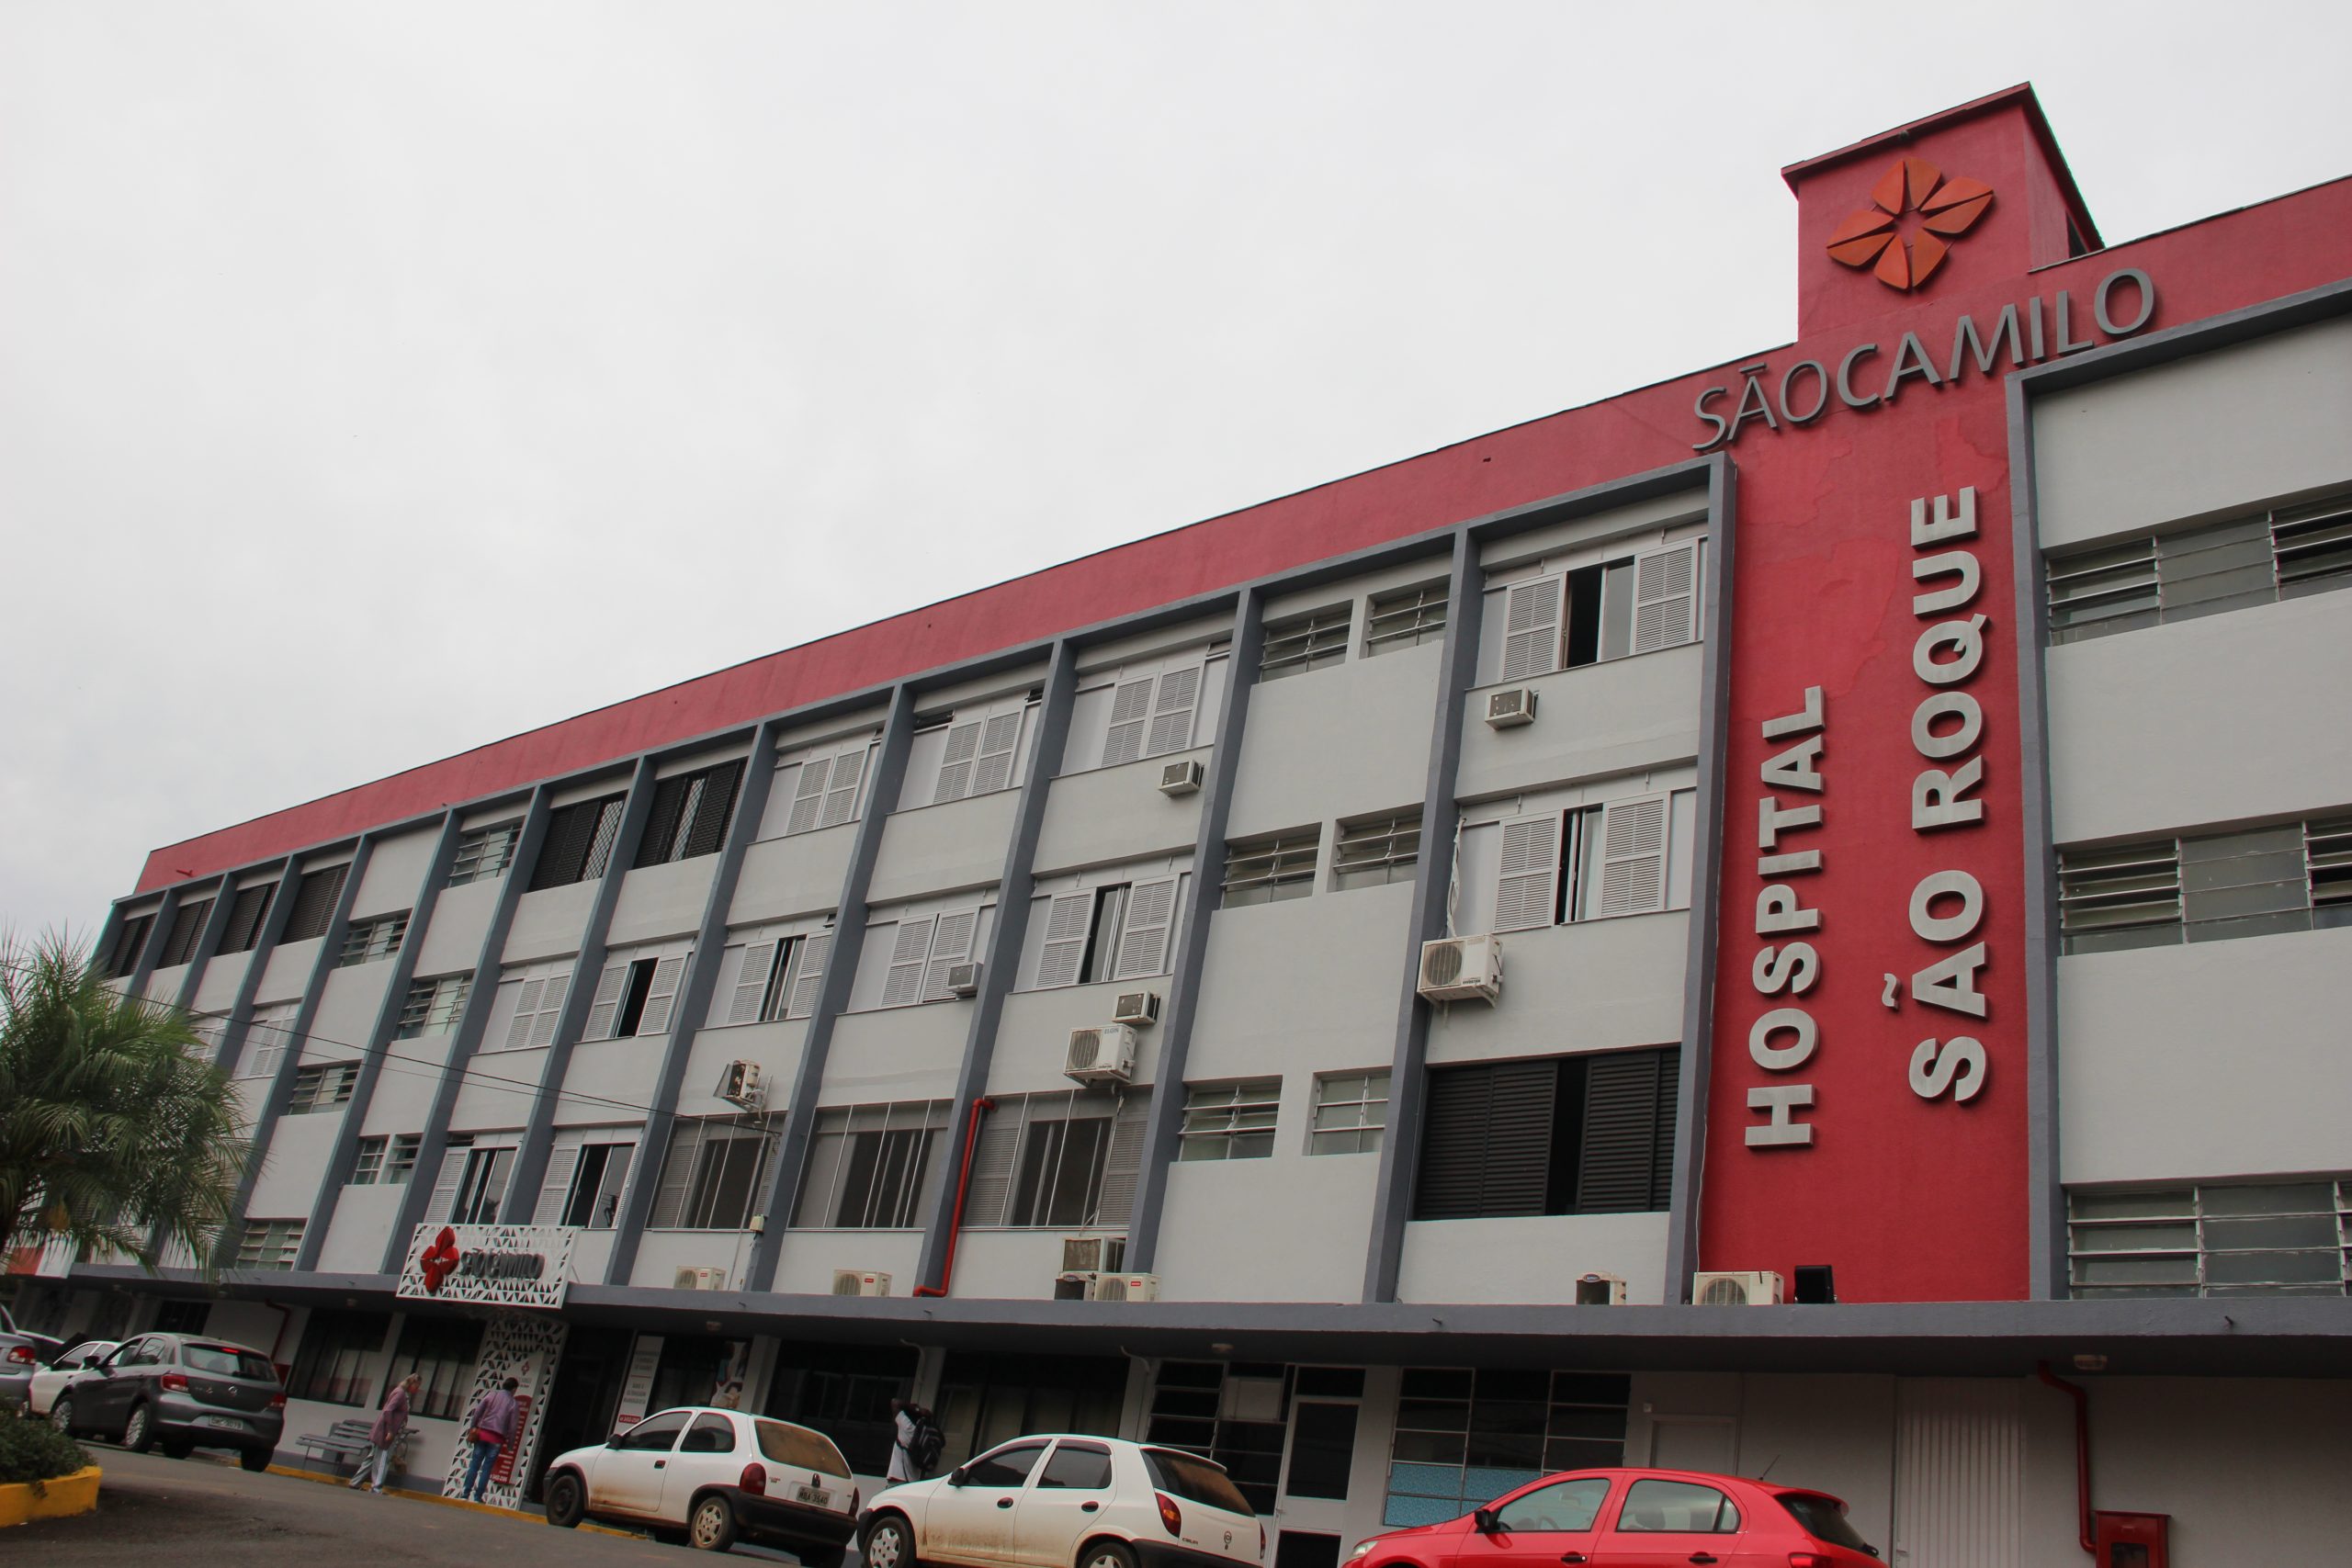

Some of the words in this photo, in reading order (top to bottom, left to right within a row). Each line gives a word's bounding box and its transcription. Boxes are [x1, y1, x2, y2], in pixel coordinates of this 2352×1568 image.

[1910, 486, 1990, 830] ROQUE
[1744, 685, 1826, 1147] HOSPITAL
[1882, 869, 1990, 1103] SÃO
